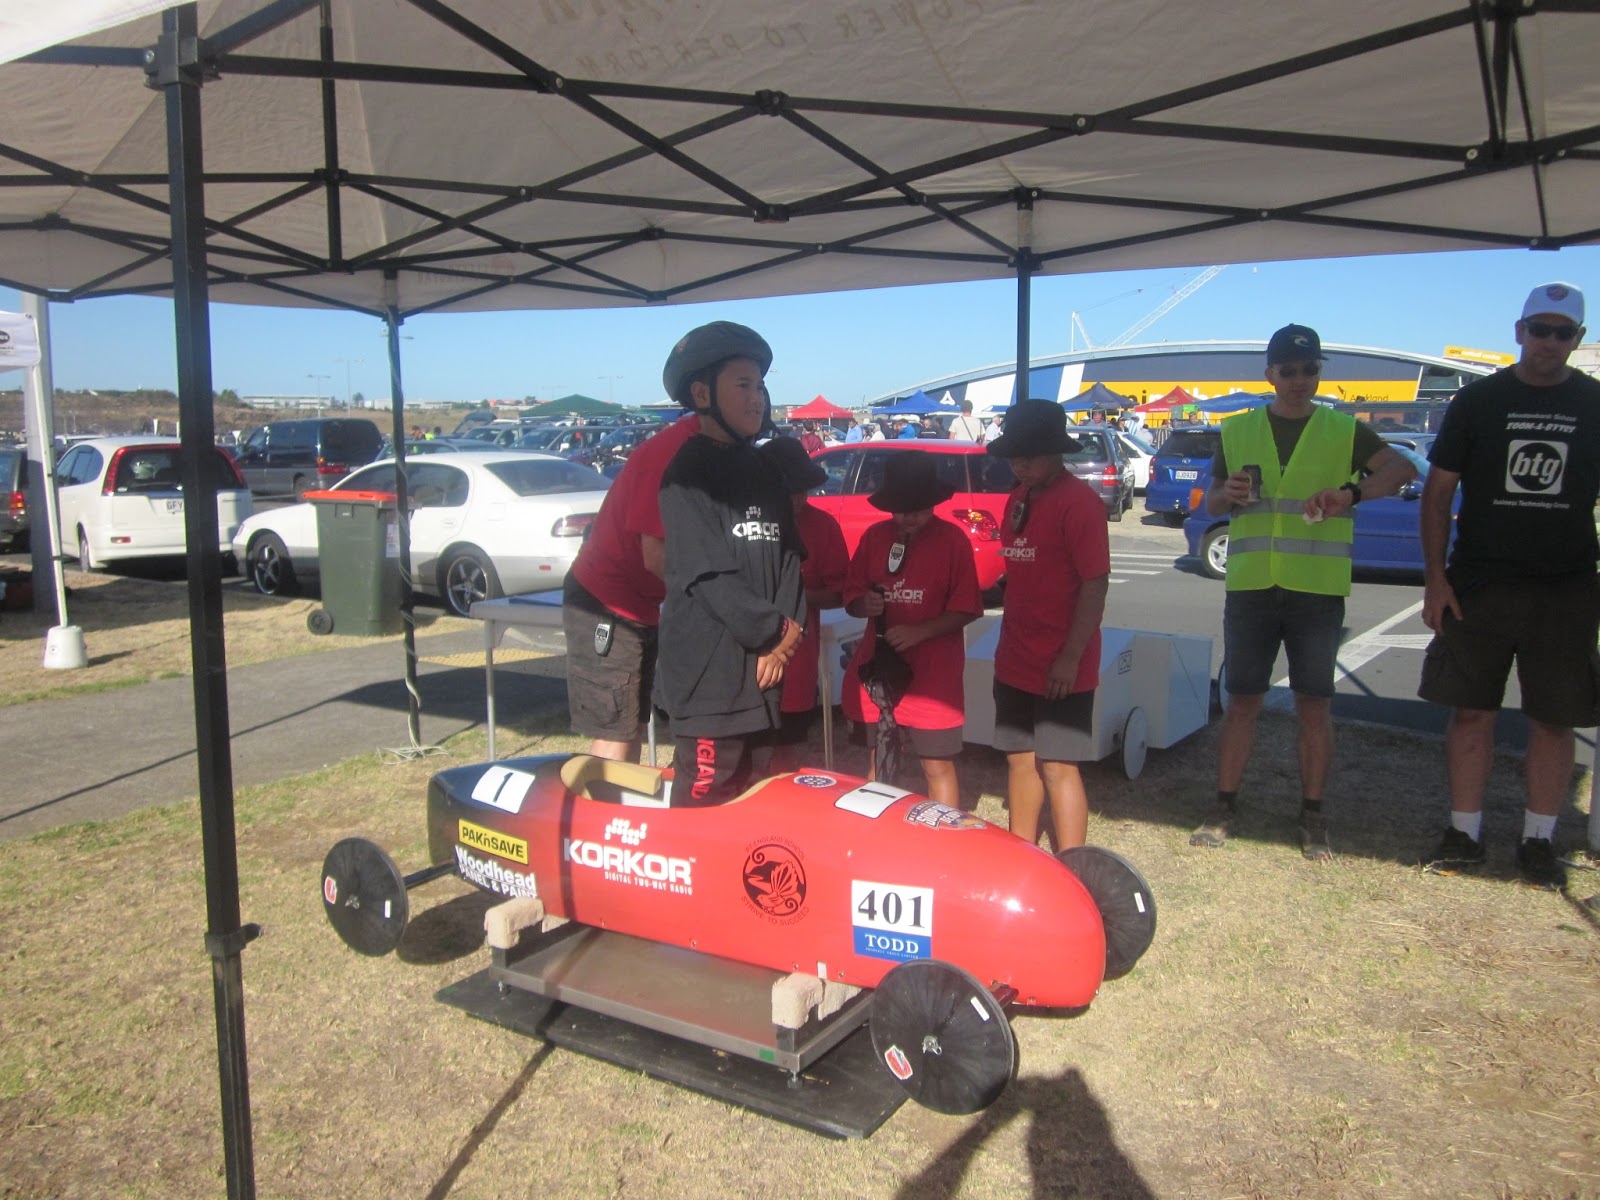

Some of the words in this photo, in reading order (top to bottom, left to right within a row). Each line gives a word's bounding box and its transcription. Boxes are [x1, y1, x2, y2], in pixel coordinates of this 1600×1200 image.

[1350, 393, 1389, 402] Akland
[1511, 452, 1561, 485] btg
[492, 772, 515, 803] 1
[563, 838, 693, 886] KORKOR
[753, 836, 783, 846] ENGLAND
[784, 838, 806, 861] SCHOOL
[454, 844, 538, 892] Woodhead
[459, 864, 491, 889] PANEL
[491, 880, 500, 893] &
[500, 882, 538, 899] PAINT
[604, 871, 632, 885] DIGITAL
[634, 877, 667, 891] TWO-WAY
[669, 883, 693, 896] RADIO
[741, 895, 765, 919] STRIVE
[767, 915, 778, 925] TO
[779, 906, 810, 926] SUCCEED
[858, 889, 926, 928] 401
[864, 933, 919, 954] TODD
